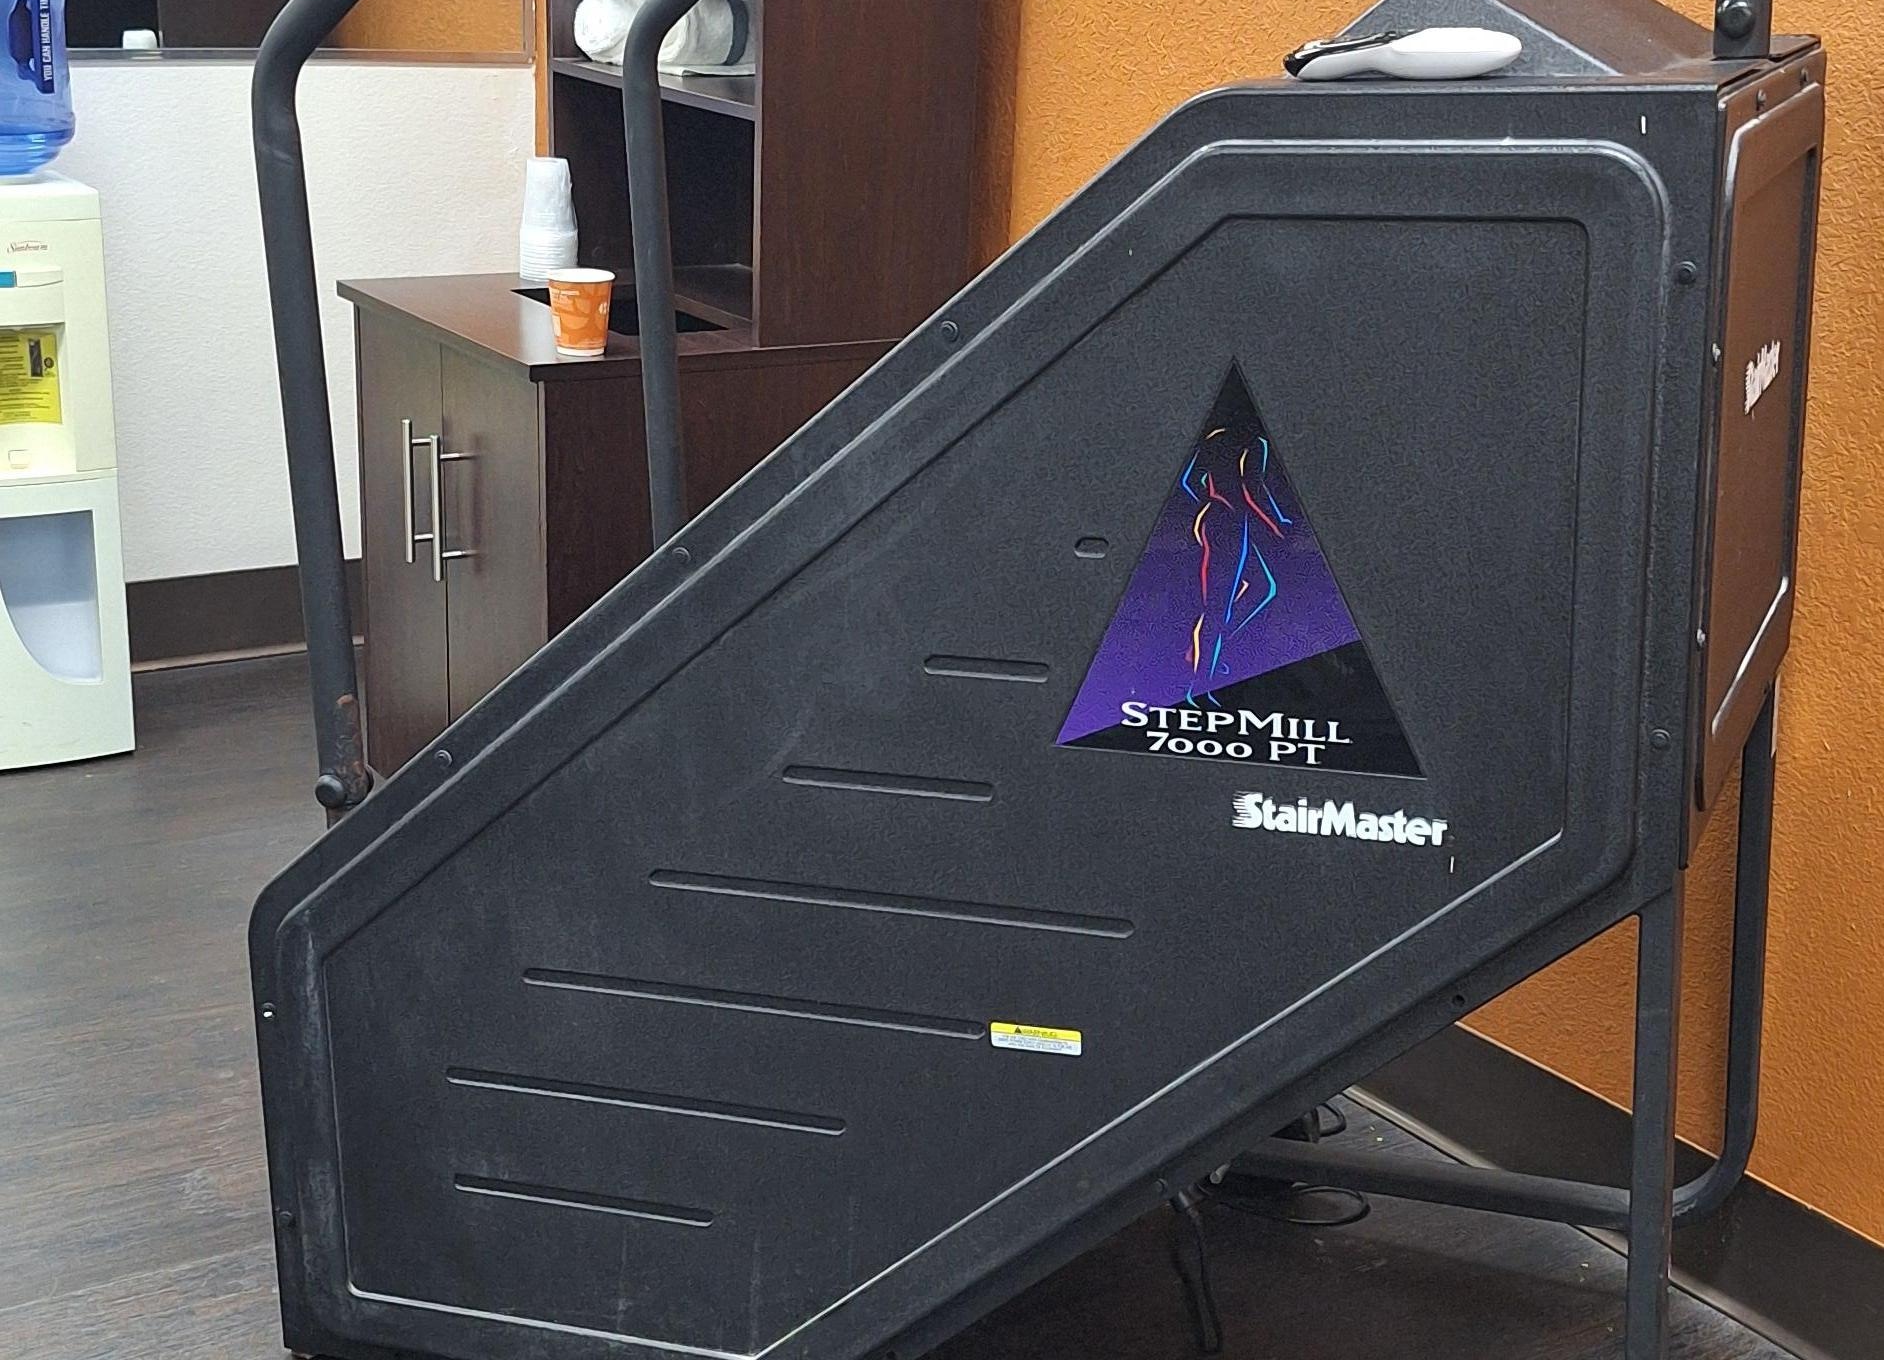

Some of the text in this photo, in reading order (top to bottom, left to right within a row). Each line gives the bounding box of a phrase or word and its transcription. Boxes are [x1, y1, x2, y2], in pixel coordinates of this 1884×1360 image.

[43, 64, 53, 82] YOU
[1145, 730, 1326, 765] 7000 PT
[1231, 790, 1448, 846] StairMaster
